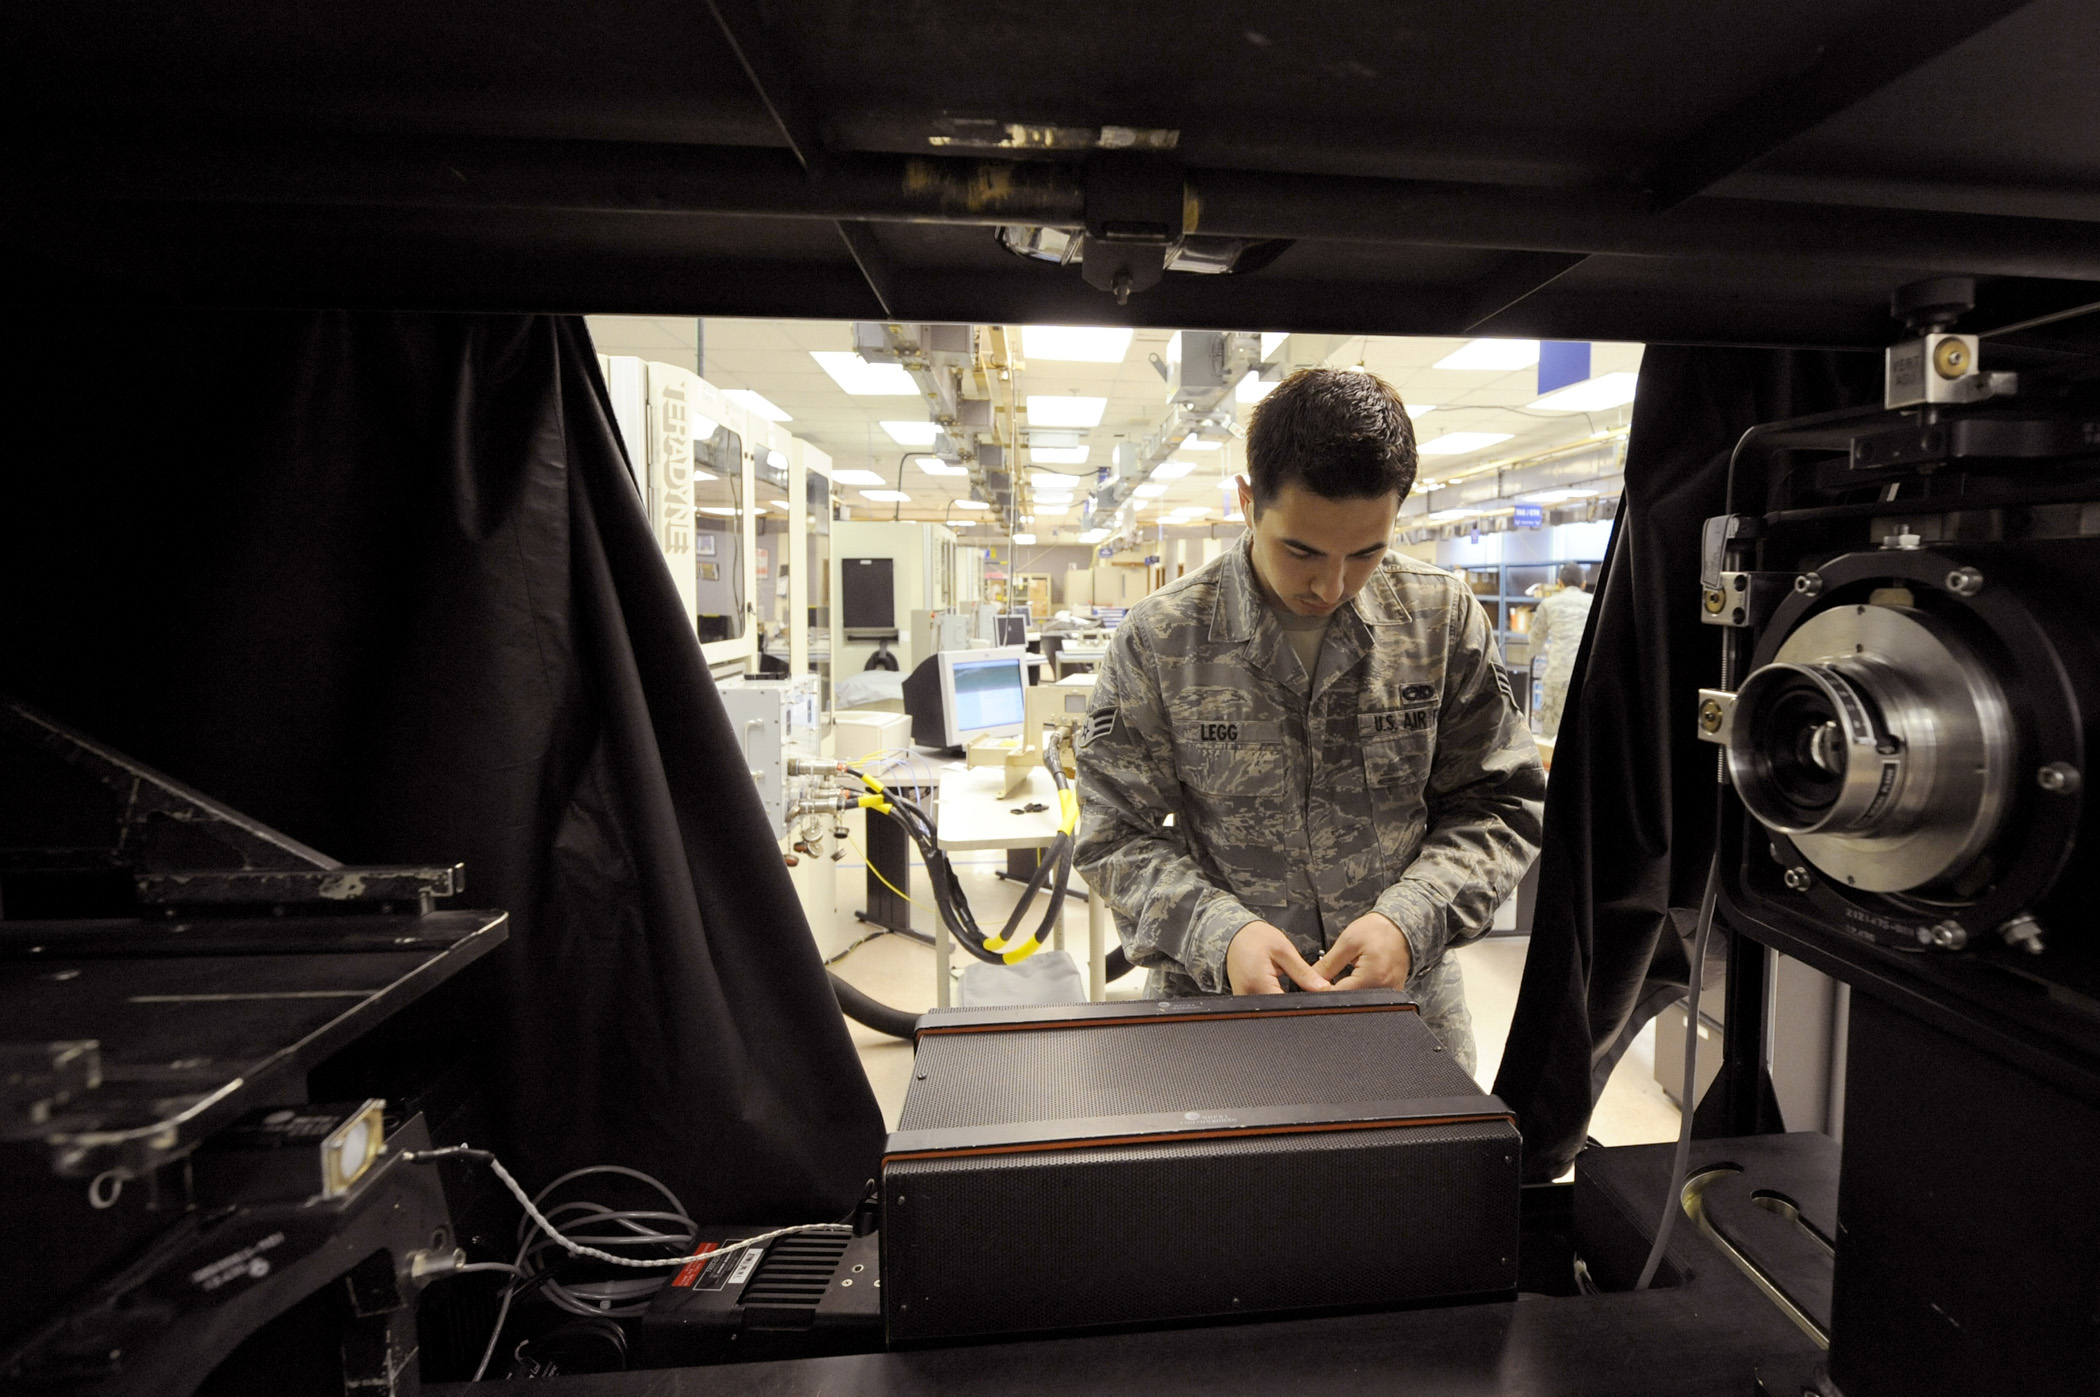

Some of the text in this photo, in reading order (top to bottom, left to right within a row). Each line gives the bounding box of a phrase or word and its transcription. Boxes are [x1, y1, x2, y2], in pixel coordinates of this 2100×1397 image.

[662, 380, 690, 555] TERADYNE
[1200, 723, 1238, 741] LEGG
[1374, 714, 1399, 732] U.S.
[1404, 712, 1427, 729] AIR
